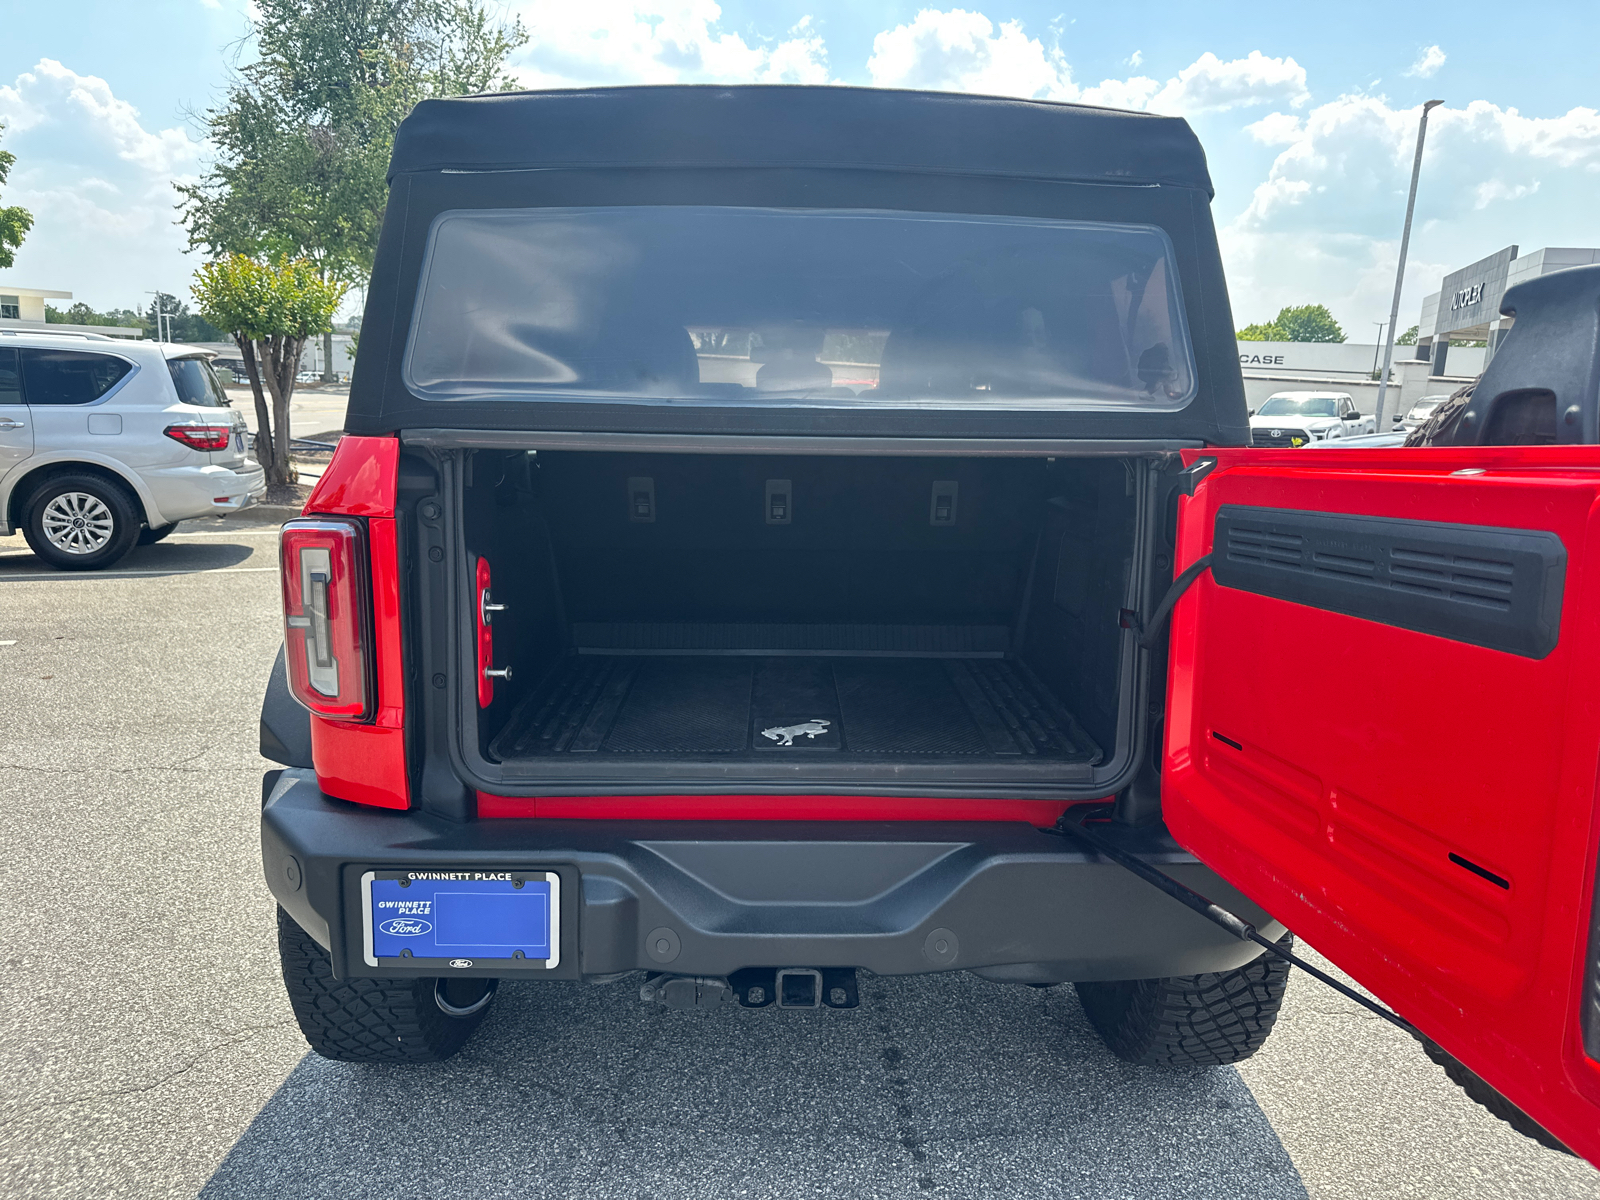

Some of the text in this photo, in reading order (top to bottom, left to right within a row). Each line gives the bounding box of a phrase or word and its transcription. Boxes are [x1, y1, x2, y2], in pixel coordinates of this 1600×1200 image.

[1239, 354, 1284, 365] CASE
[407, 872, 512, 881] GWINNETT PLACE
[398, 907, 431, 915] PLACE
[389, 919, 422, 934] Ford
